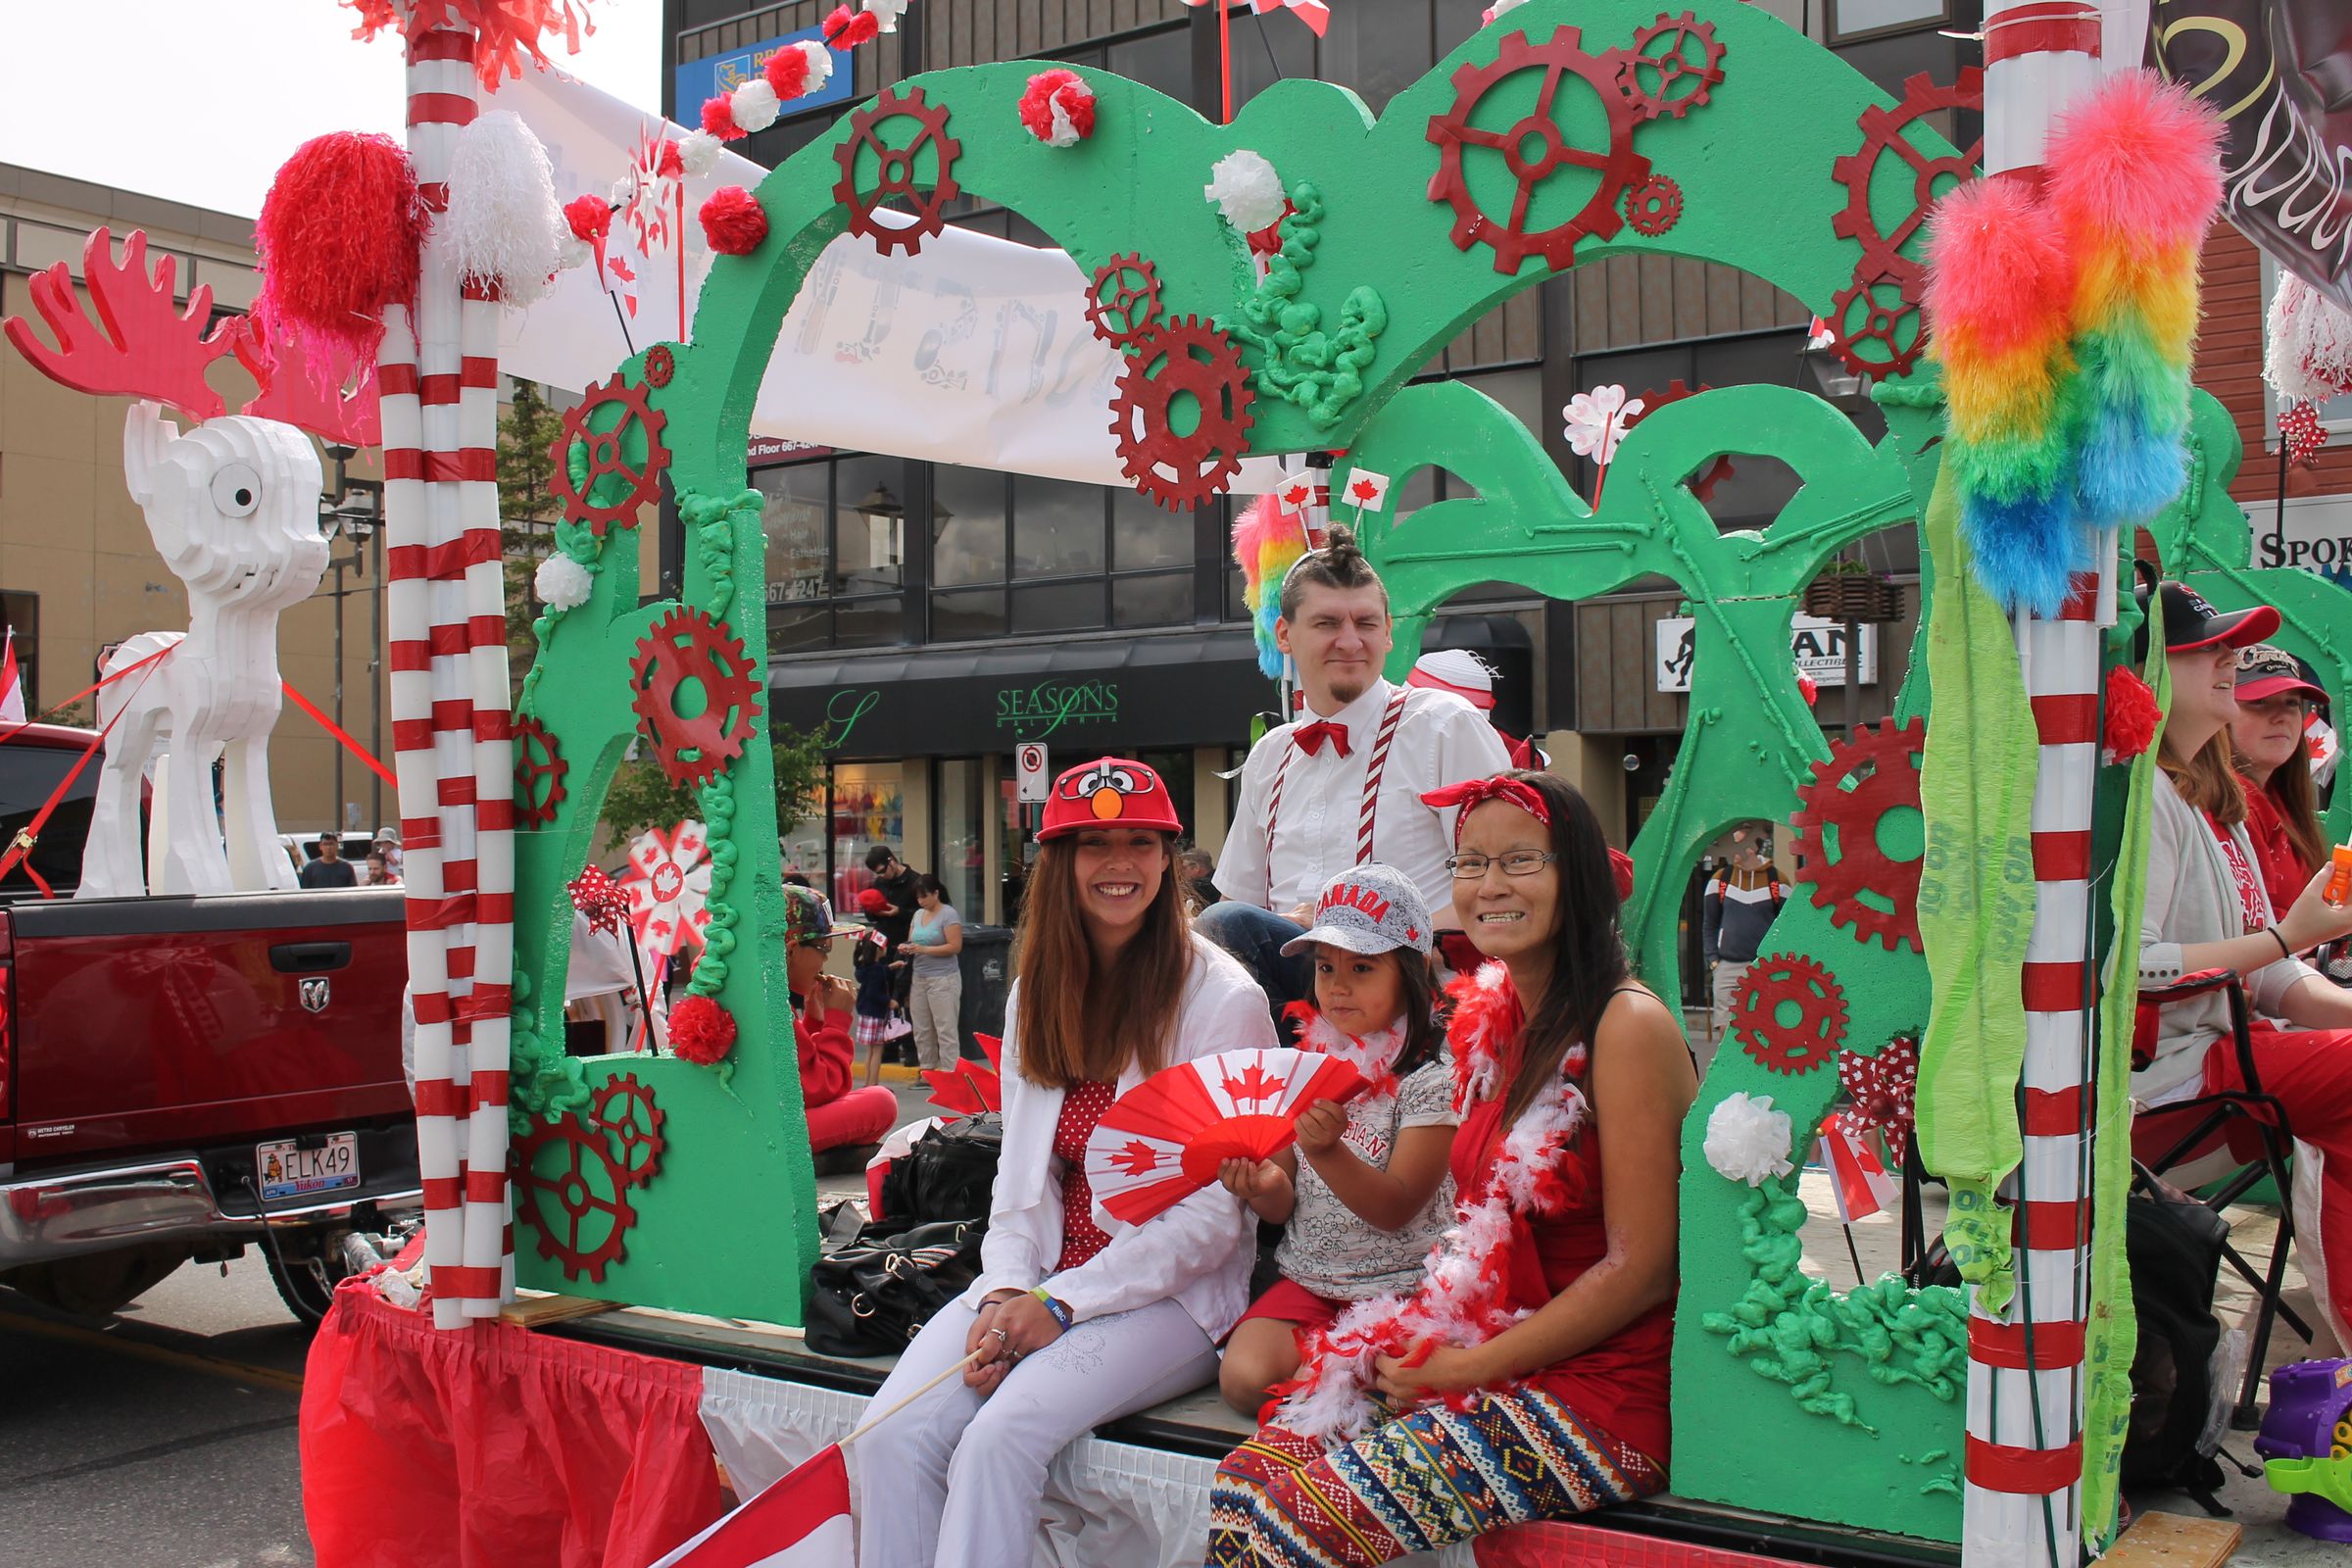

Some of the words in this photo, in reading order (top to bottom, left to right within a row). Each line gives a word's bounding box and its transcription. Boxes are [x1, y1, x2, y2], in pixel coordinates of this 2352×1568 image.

[759, 444, 780, 455] Floor
[765, 579, 824, 601] 67-4247
[996, 678, 1118, 731] SEASONS
[997, 715, 1117, 727] GALLERIA
[286, 1147, 350, 1180] ELK49
[295, 1179, 325, 1192] Yukon
[1053, 1305, 1066, 1322] RBC
